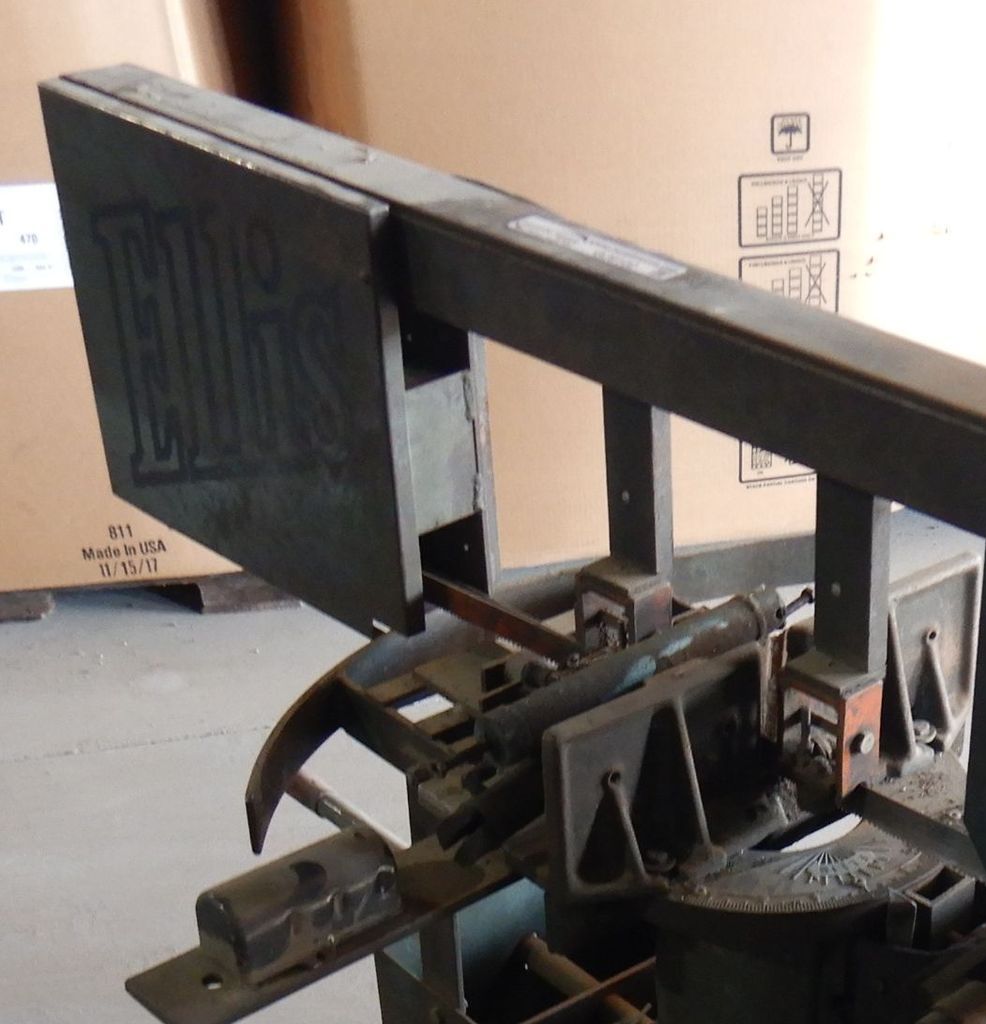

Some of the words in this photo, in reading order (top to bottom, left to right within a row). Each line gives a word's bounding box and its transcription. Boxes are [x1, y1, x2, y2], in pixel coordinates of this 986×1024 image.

[108, 523, 133, 540] 811
[82, 545, 121, 560] Made
[139, 539, 167, 556] USA
[99, 557, 157, 578] 11/15/17
